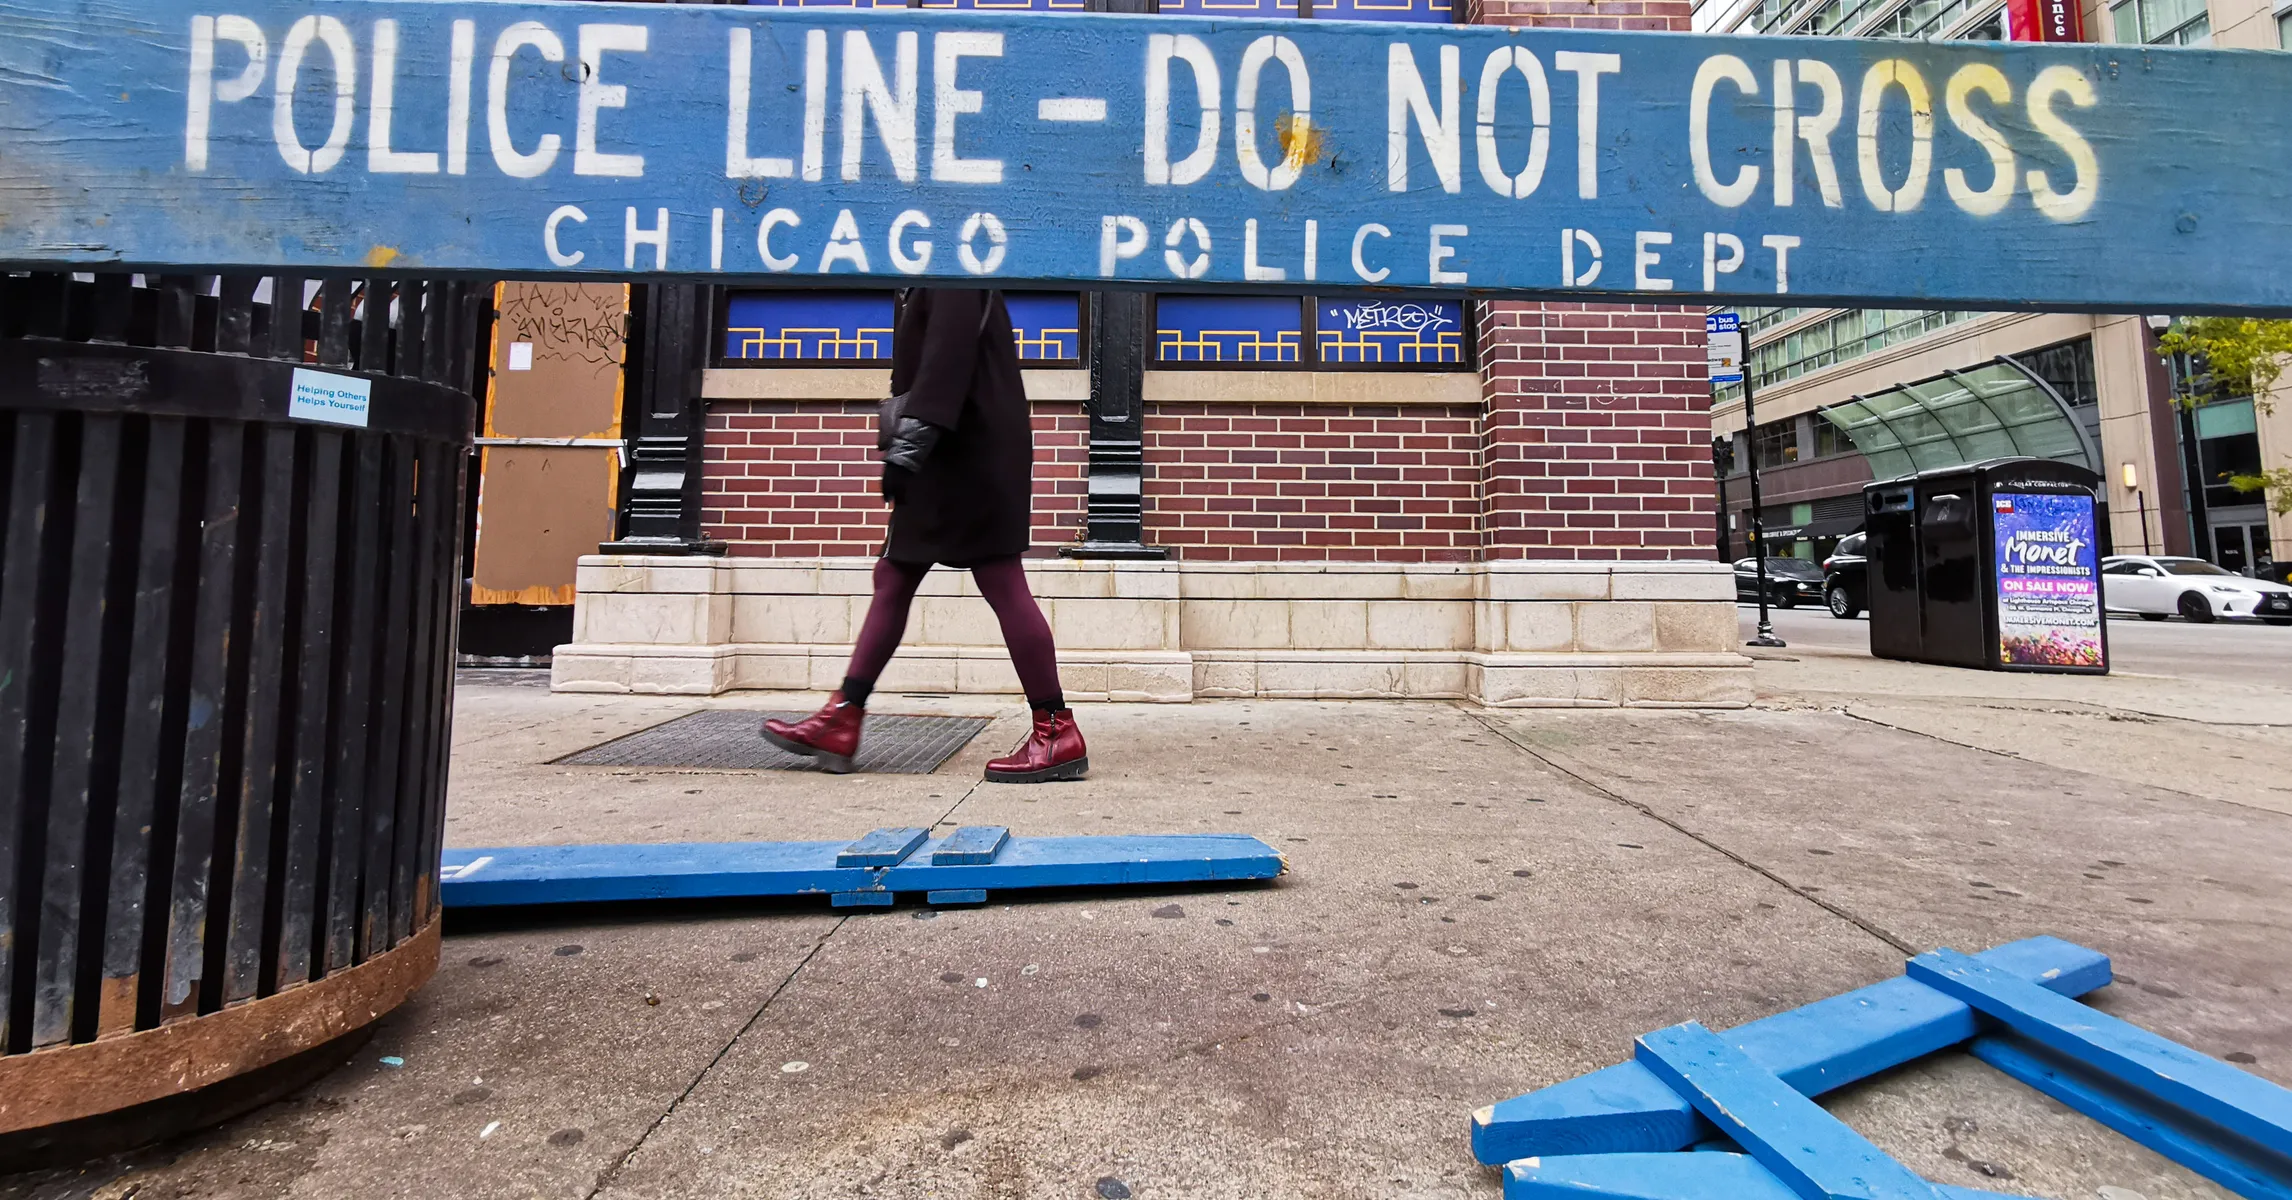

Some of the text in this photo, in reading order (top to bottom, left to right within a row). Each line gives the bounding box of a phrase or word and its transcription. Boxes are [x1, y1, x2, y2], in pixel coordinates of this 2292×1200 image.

[2052, 0, 2065, 36] nce
[185, 14, 649, 178] POLICE
[725, 27, 1005, 185] LINE
[1144, 33, 1317, 192] DO
[1386, 42, 1621, 200] NOT
[1689, 53, 2101, 224] CROSS
[544, 204, 1801, 294] CHICAGO POLICE DEPT
[1718, 316, 1734, 324] bus
[1718, 323, 1737, 331] stop
[297, 384, 367, 402] Helping Others
[297, 395, 366, 412] Helps Yourself
[2016, 530, 2070, 543] IMMERSIVE
[2005, 536, 2086, 566] Monet
[2000, 563, 2091, 576] & THE IMPRESSIONISTS
[2003, 581, 2090, 593] ON SALE NOW
